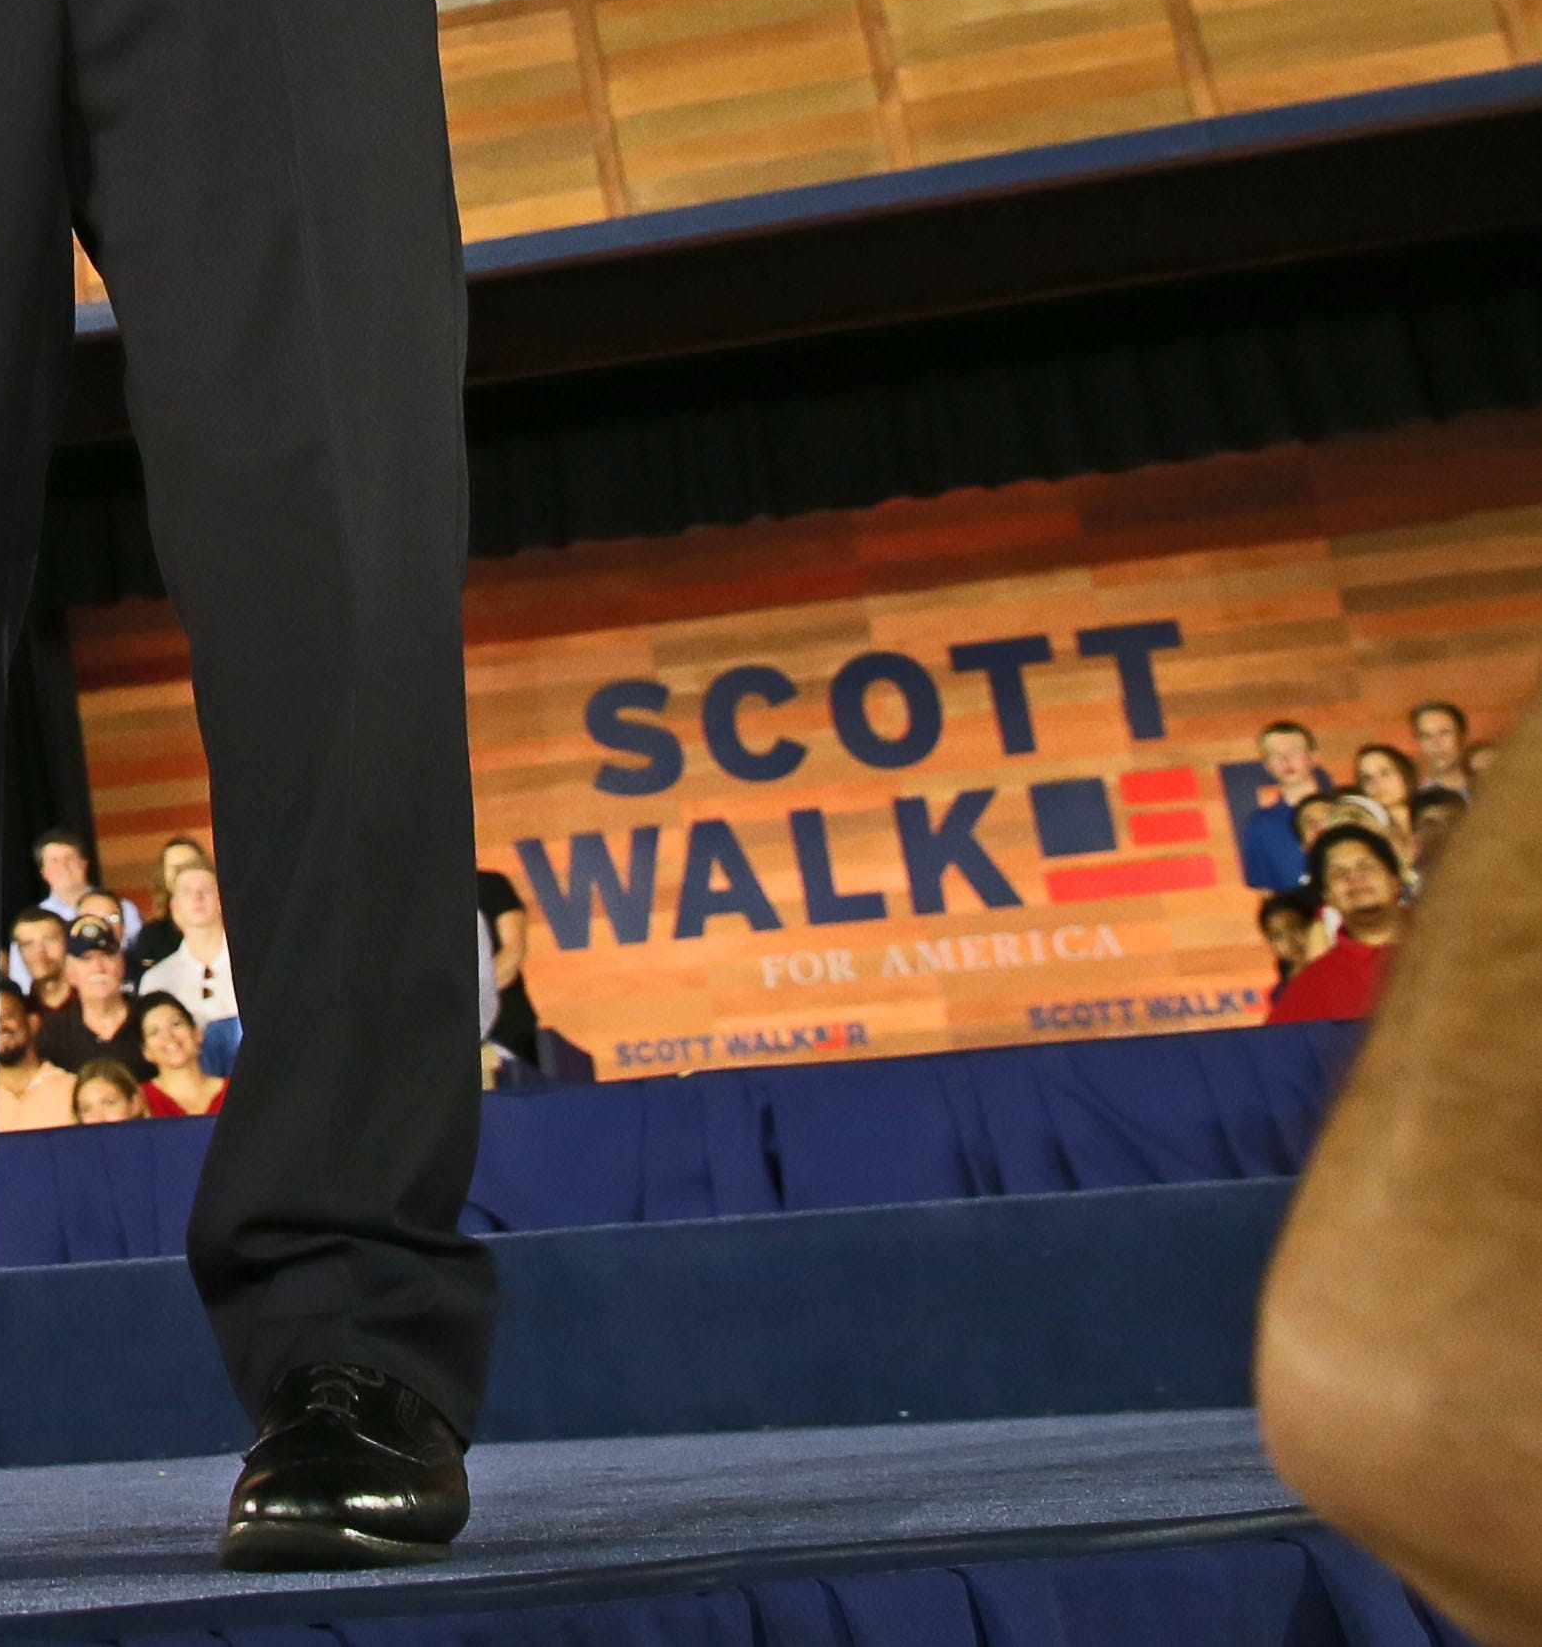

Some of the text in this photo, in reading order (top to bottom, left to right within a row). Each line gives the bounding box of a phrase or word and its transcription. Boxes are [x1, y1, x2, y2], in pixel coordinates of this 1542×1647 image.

[585, 620, 1182, 796] SCOTT
[761, 923, 1124, 989] FOR AMERICA
[1028, 998, 1135, 1031] SCOTT
[617, 1034, 714, 1067] SCOTT
